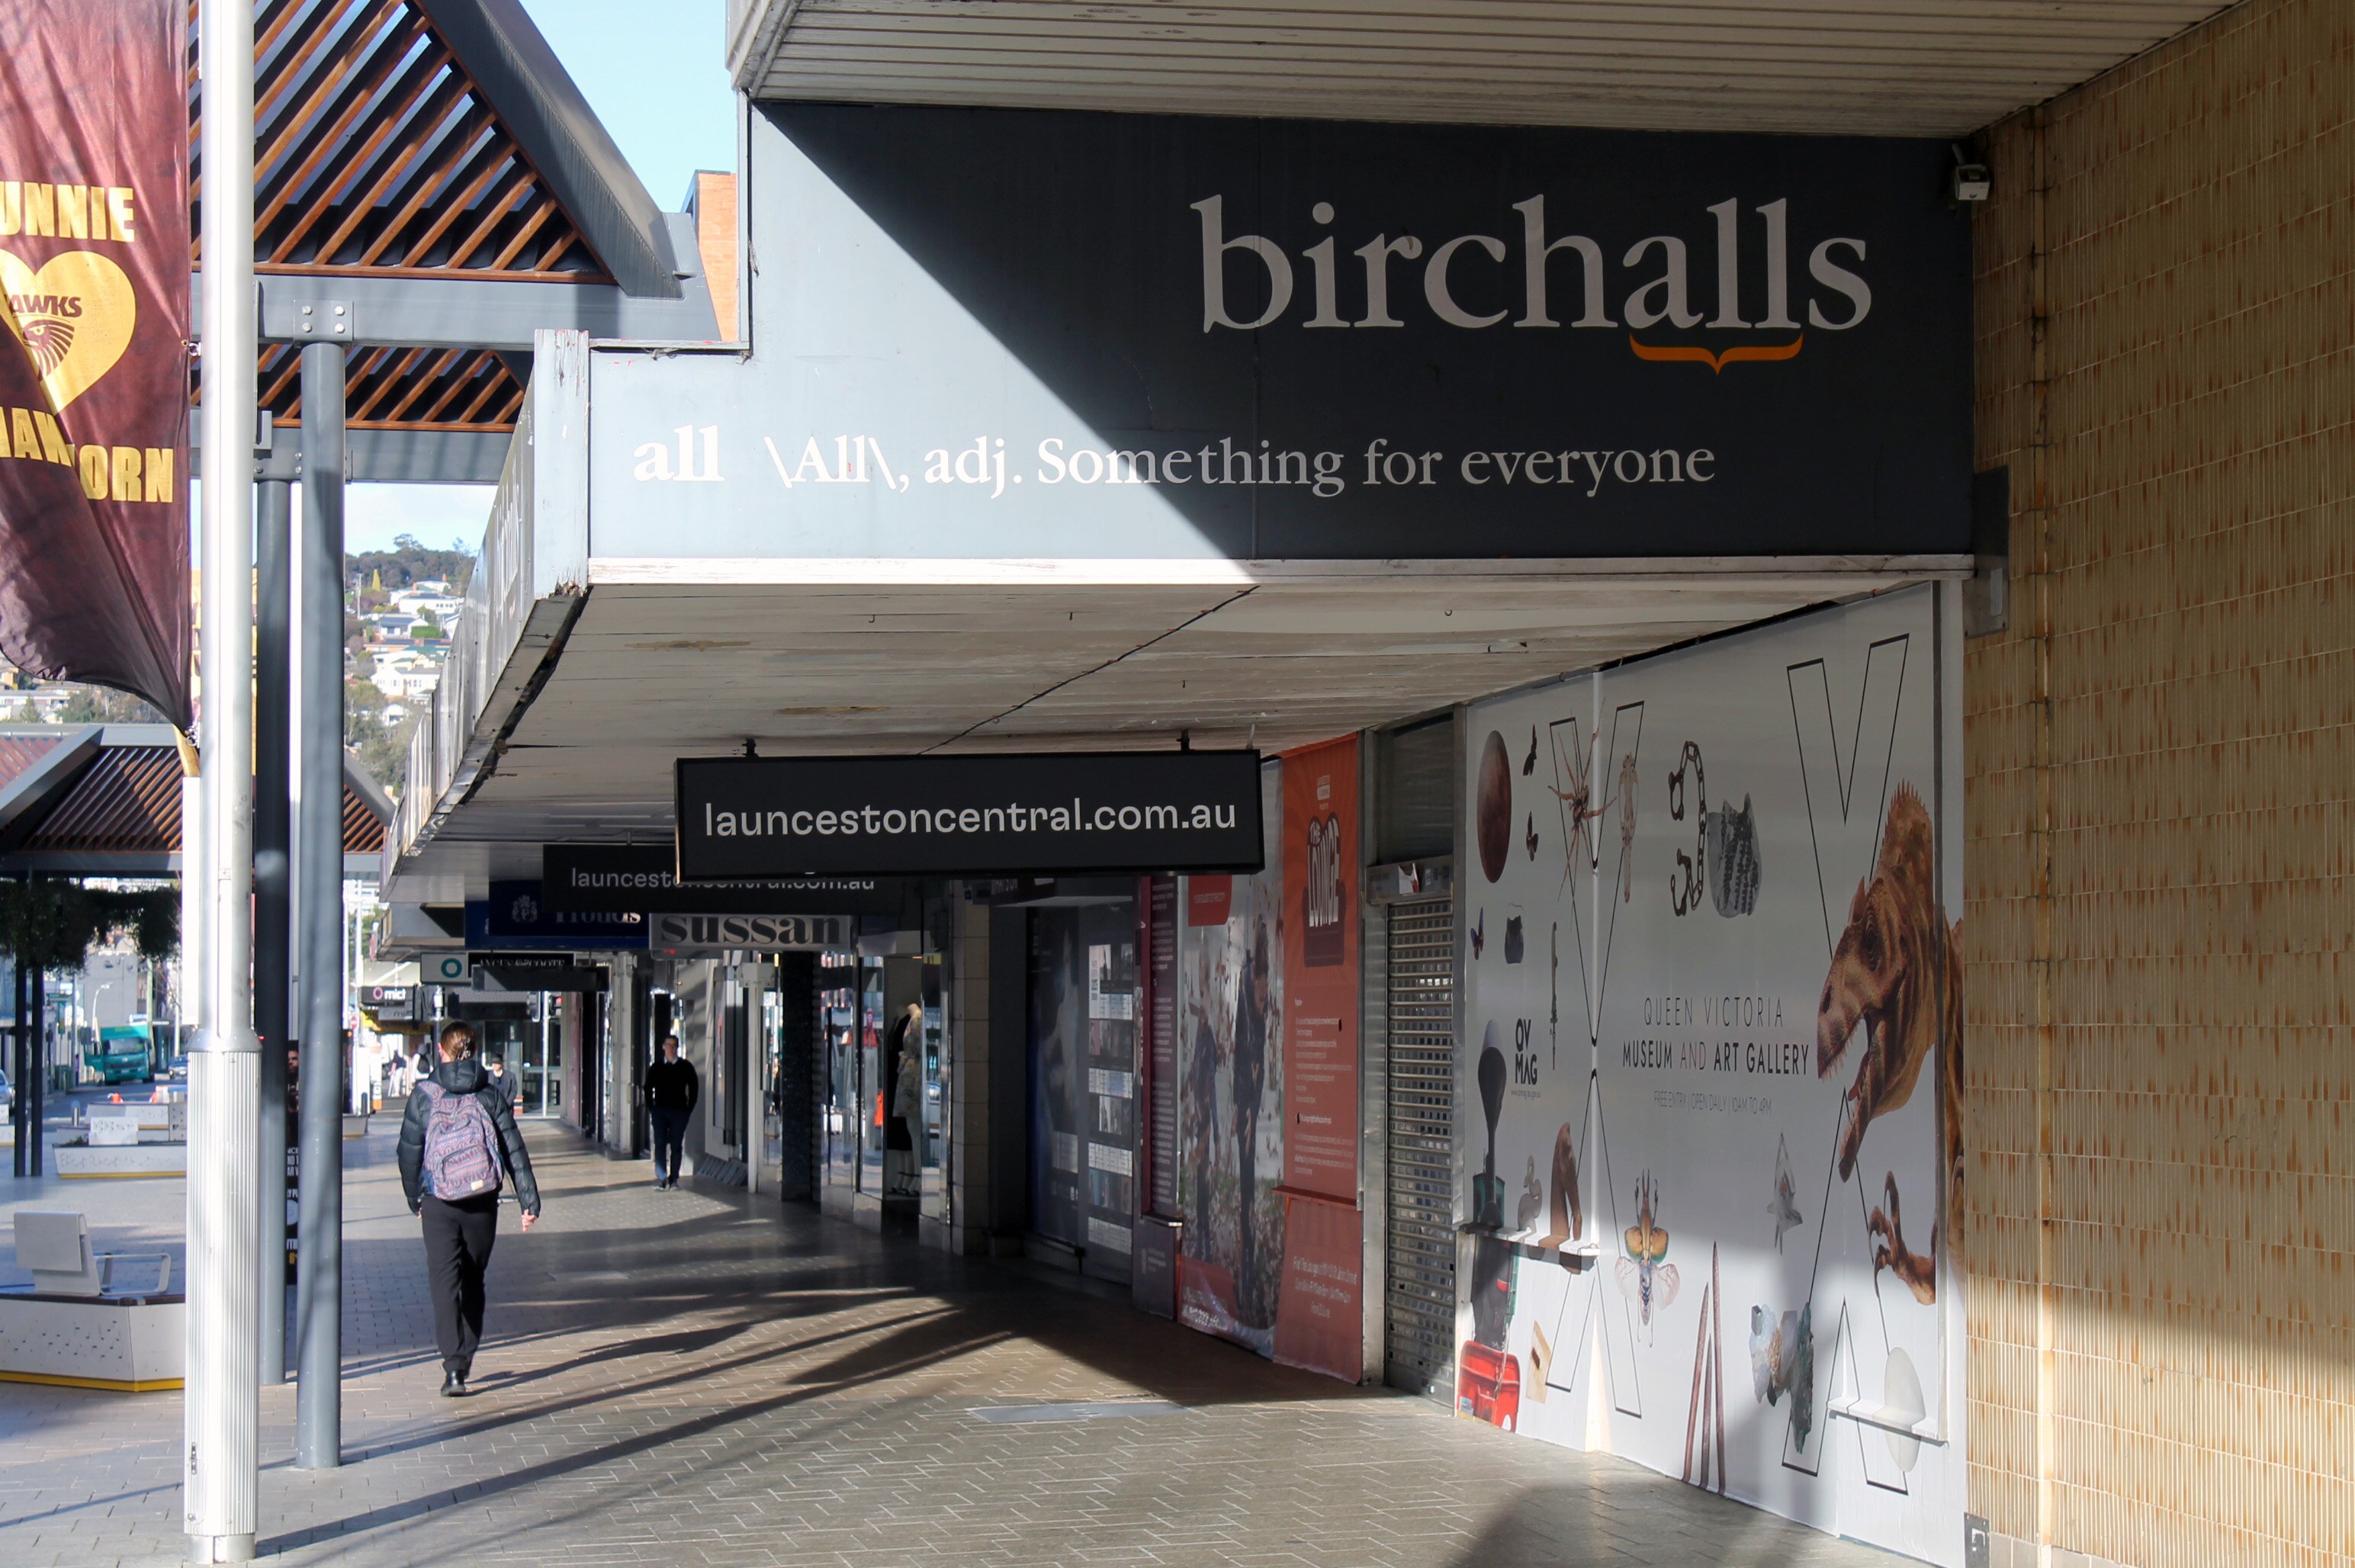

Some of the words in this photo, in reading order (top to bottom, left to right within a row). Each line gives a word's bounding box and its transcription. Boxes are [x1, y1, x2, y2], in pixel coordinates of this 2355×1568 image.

[1190, 194, 1873, 333] birchalls
[632, 424, 724, 482] all
[924, 435, 1023, 499] adj.
[1038, 437, 1345, 497] Something
[1363, 438, 1443, 486] for
[1460, 448, 1715, 497] everyone
[704, 798, 1236, 837] launcestoncentral.com.au
[1307, 818, 1340, 927] LOUNGE
[660, 915, 840, 945] sussan
[1643, 997, 1693, 1026] QUEEN
[1704, 997, 1784, 1027] VICTORIA
[1515, 1017, 1531, 1052] QV
[1515, 1053, 1537, 1086] MAG
[1622, 1039, 1673, 1069] MUSEUM
[1680, 1042, 1707, 1070] AND
[1713, 1042, 1740, 1072] ART
[1746, 1043, 1810, 1075] GALLERY
[1691, 1093, 1708, 1110] OPEN
[1708, 1094, 1727, 1112] DAILY
